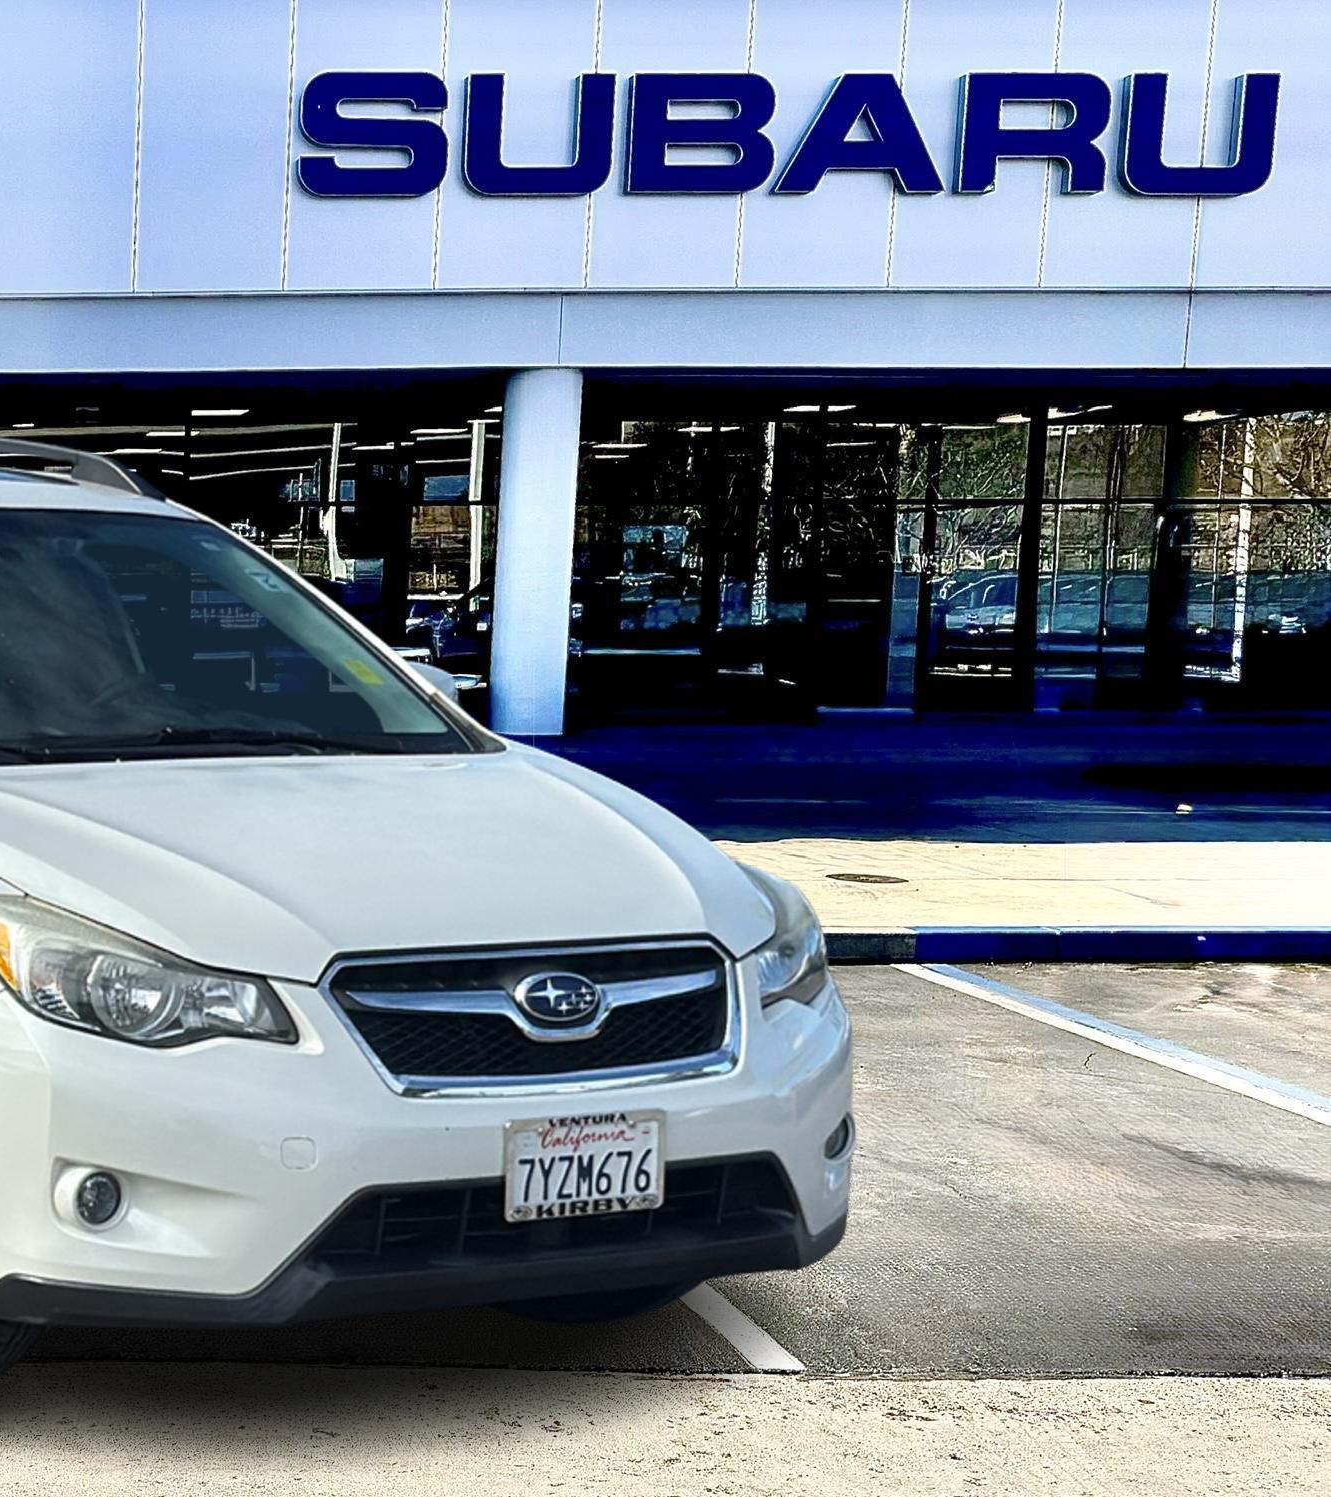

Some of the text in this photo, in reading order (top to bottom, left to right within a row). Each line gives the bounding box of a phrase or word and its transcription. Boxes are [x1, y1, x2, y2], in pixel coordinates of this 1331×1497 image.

[297, 71, 1281, 199] SUBARU
[548, 1113, 627, 1127] VENTURA
[541, 1126, 635, 1152] California
[518, 1148, 653, 1203] 7YZM676
[535, 1196, 637, 1218] KIRBY
